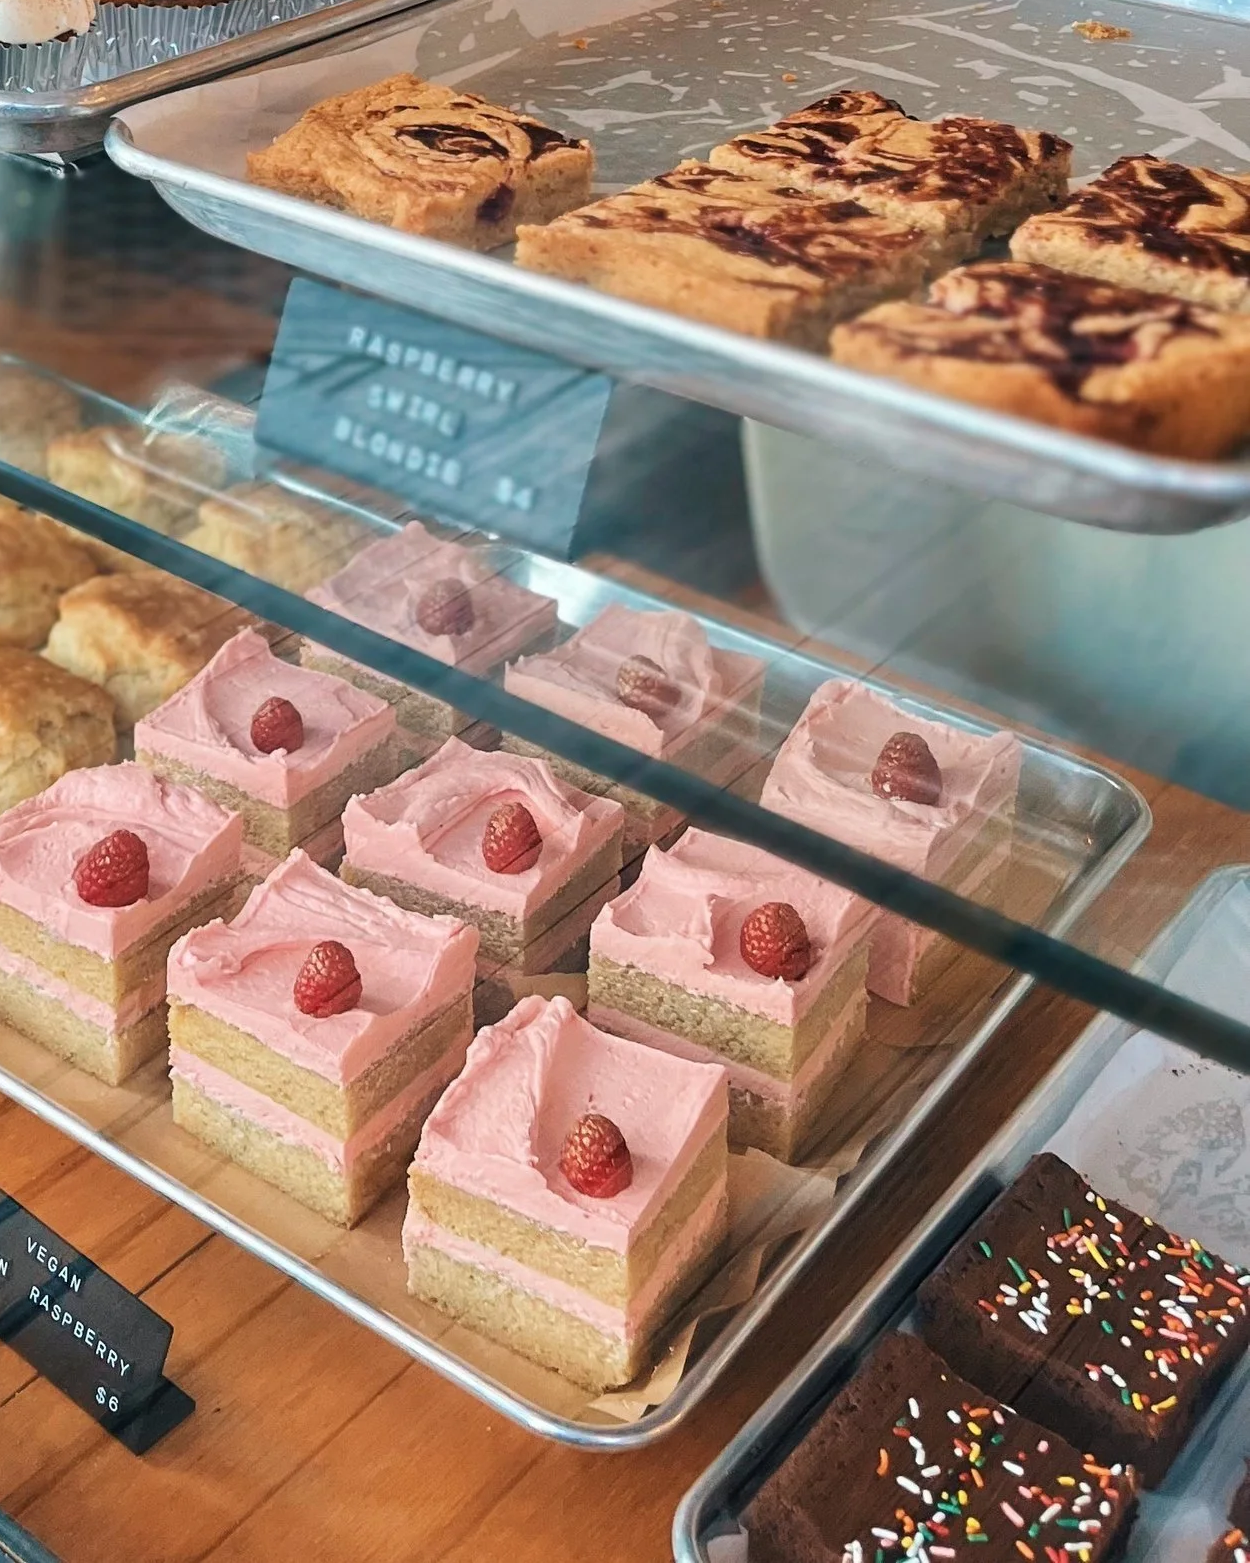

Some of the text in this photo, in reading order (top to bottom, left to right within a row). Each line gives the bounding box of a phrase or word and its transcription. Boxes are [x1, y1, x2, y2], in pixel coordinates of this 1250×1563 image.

[348, 326, 515, 402] RASPBERRY
[27, 1237, 82, 1292] VEGAN
[29, 1286, 130, 1377] RASPBERRY
[96, 1387, 119, 1412] $6
